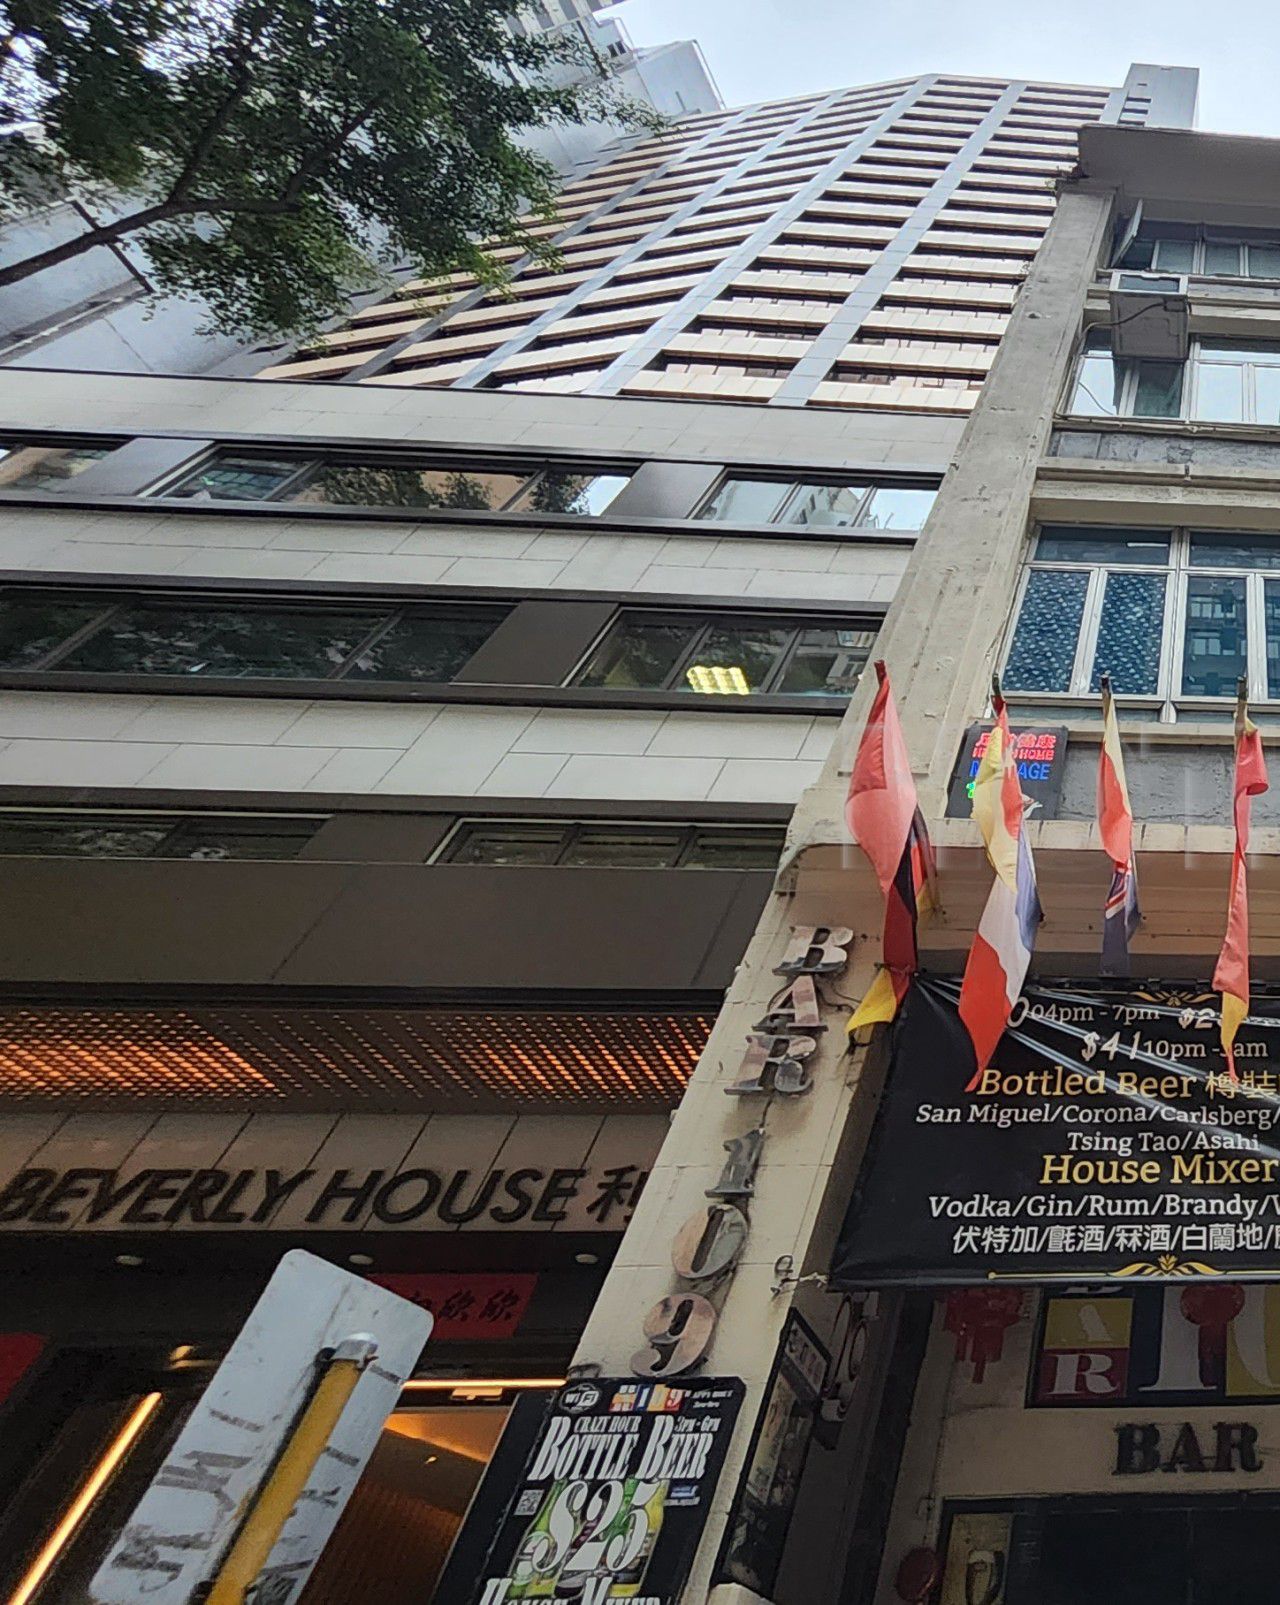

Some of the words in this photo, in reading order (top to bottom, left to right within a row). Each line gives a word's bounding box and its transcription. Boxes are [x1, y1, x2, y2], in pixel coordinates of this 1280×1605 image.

[975, 732, 1057, 749] 足健康
[969, 760, 1051, 780] MAGE
[723, 924, 854, 1096] BAR
[1112, 1004, 1160, 1025] 7pm
[1144, 1038, 1207, 1061] 10pm
[977, 1066, 1107, 1099] Bottled
[1118, 1069, 1196, 1099] Beer
[916, 1103, 963, 1124] San
[1067, 1131, 1133, 1156] Tsing
[1138, 1130, 1260, 1152] Tao/Asahi
[1040, 1153, 1162, 1185] House
[1172, 1153, 1279, 1184] Mixer
[0, 1167, 314, 1224] BEVERLY
[305, 1167, 589, 1224] HOUSE
[630, 1126, 766, 1378] 109
[573, 1415, 609, 1433] CRAZY
[527, 1415, 641, 1482] BOTTLE
[635, 1414, 714, 1479] BEER
[1111, 1422, 1263, 1476] BAR
